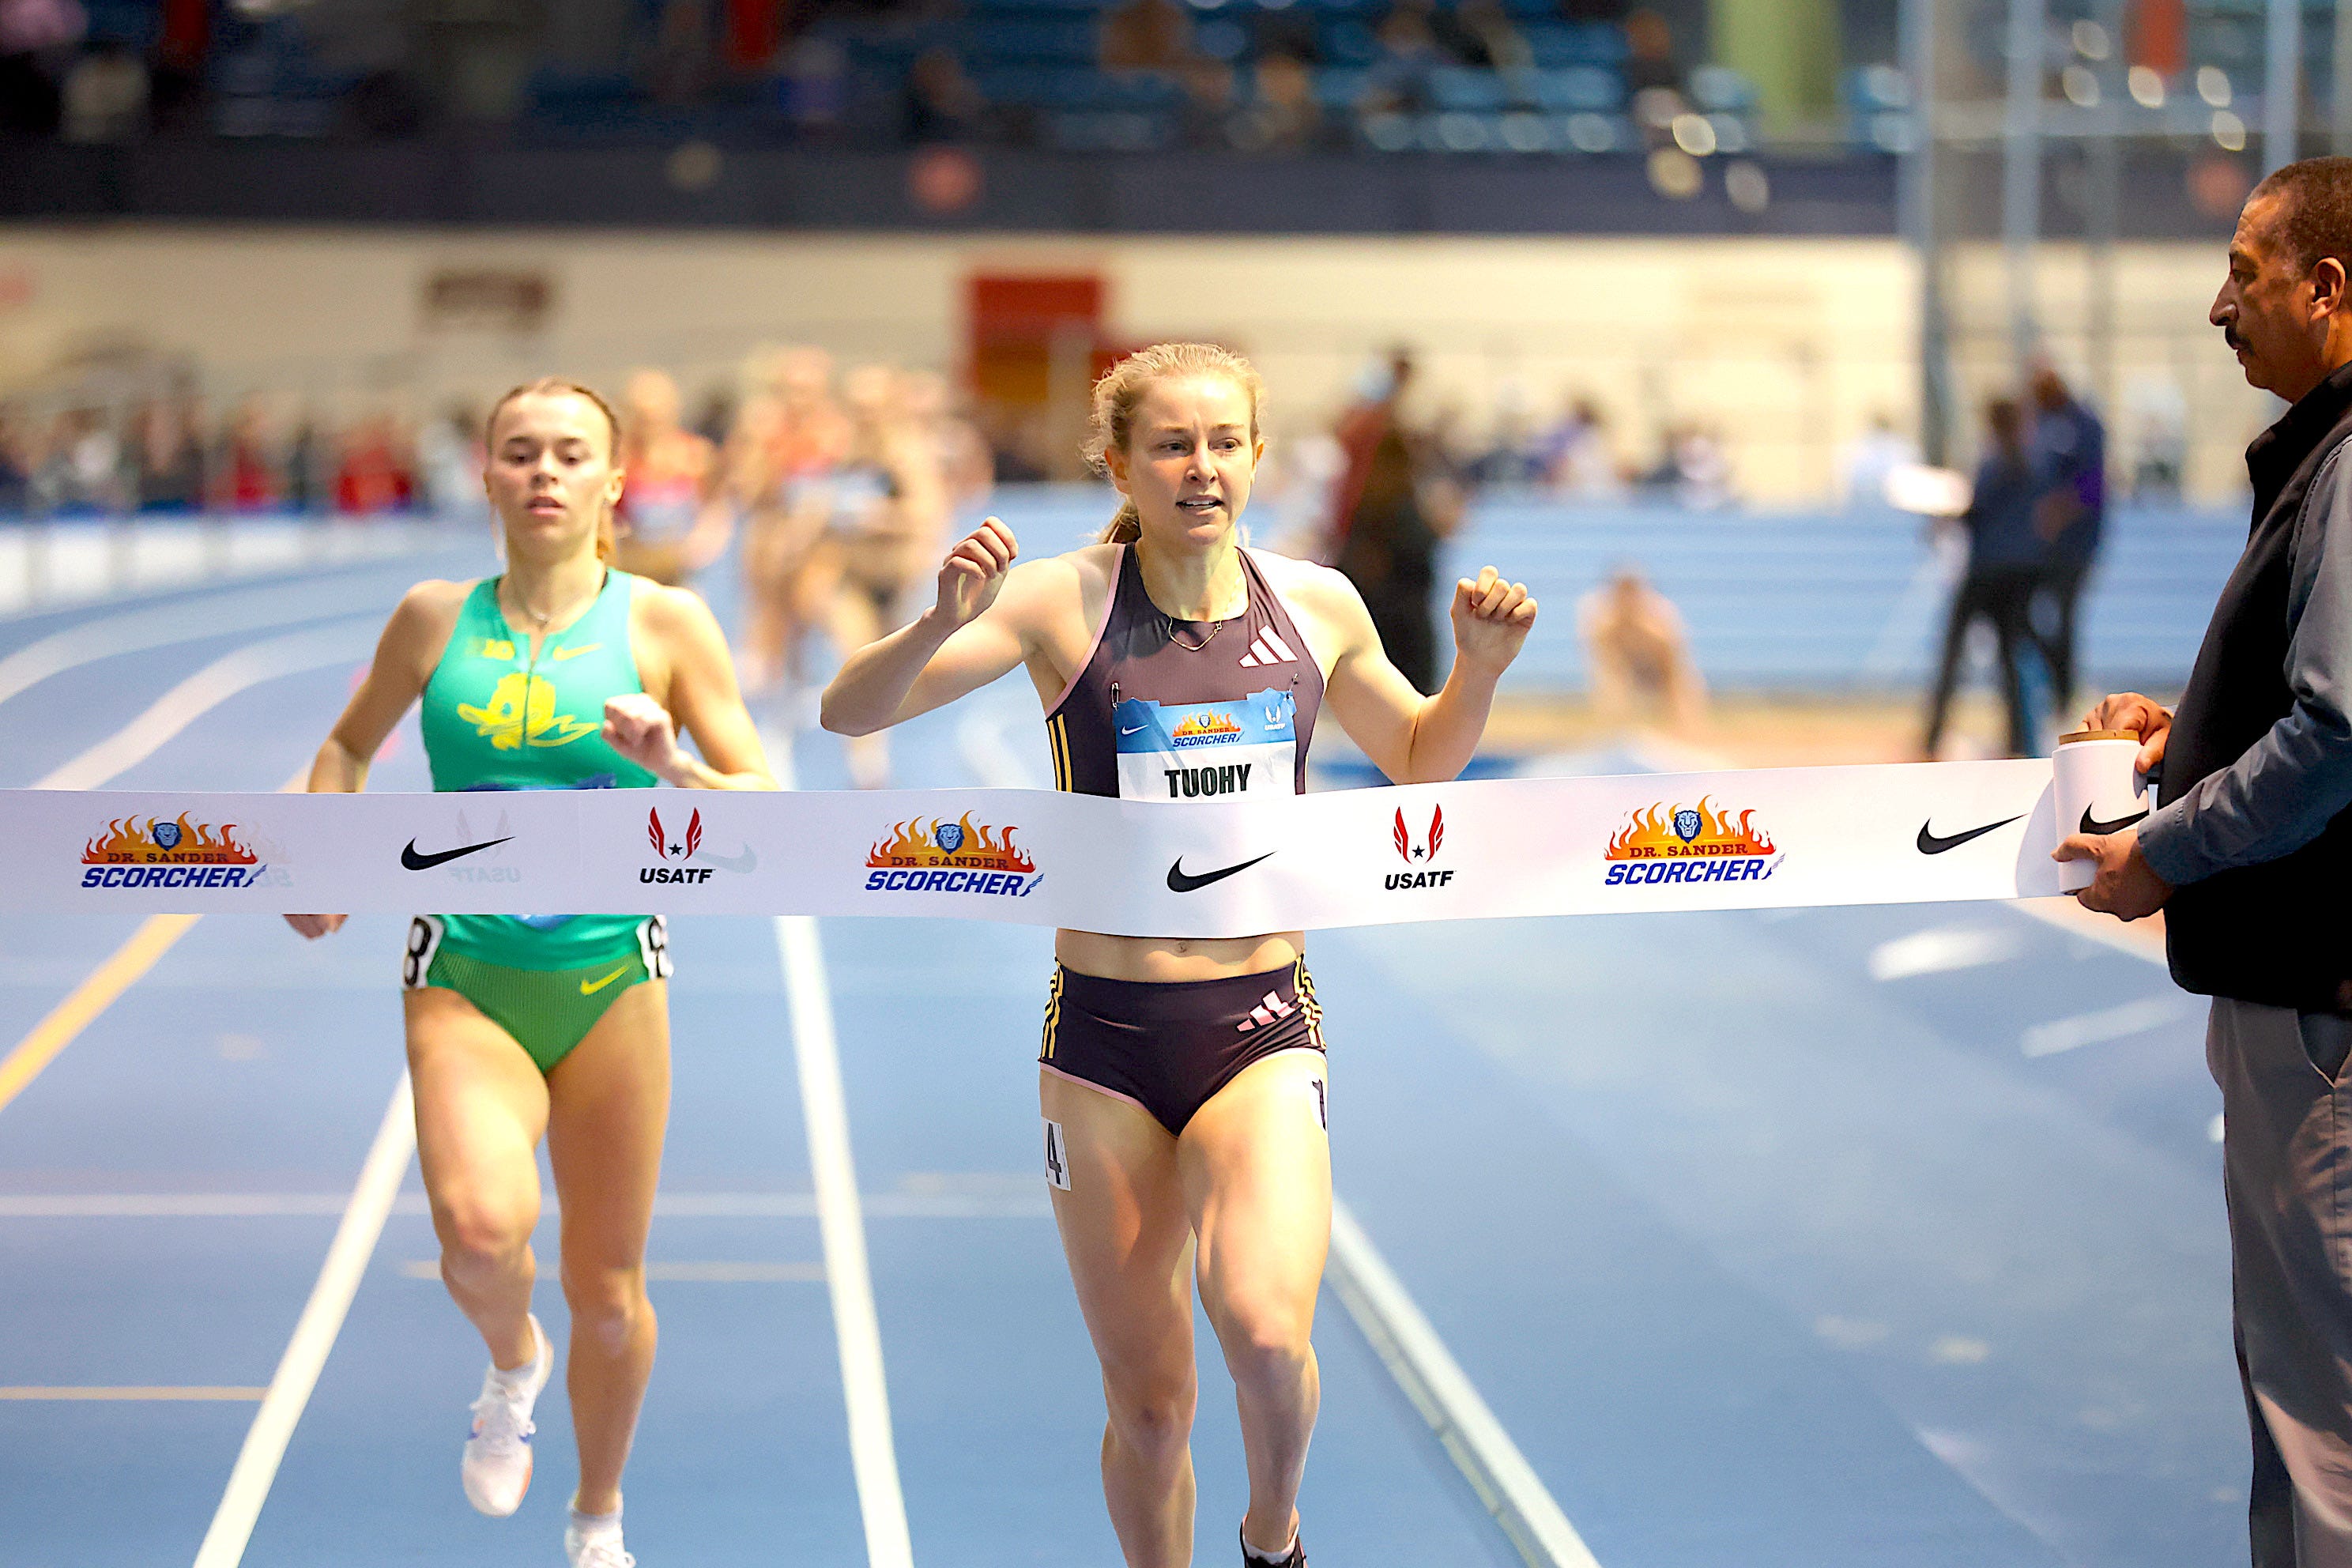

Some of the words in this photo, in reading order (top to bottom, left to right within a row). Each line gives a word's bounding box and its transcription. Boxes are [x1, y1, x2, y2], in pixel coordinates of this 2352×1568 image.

[1173, 733, 1237, 748] SCORCHER
[1164, 763, 1252, 798] TUOHY
[107, 852, 141, 863] DR.
[146, 852, 229, 863] SANDER
[1630, 846, 1661, 858] DR.
[1668, 843, 1748, 857] SANDER
[891, 857, 922, 867] DR.
[929, 857, 1009, 869] SANDER
[1605, 859, 1765, 885] SCORCHER
[81, 868, 247, 888] SCORCHER
[639, 868, 713, 884] USATF
[865, 870, 1024, 896] SCORCHER
[1385, 870, 1454, 891] USATF
[405, 916, 432, 986] 8
